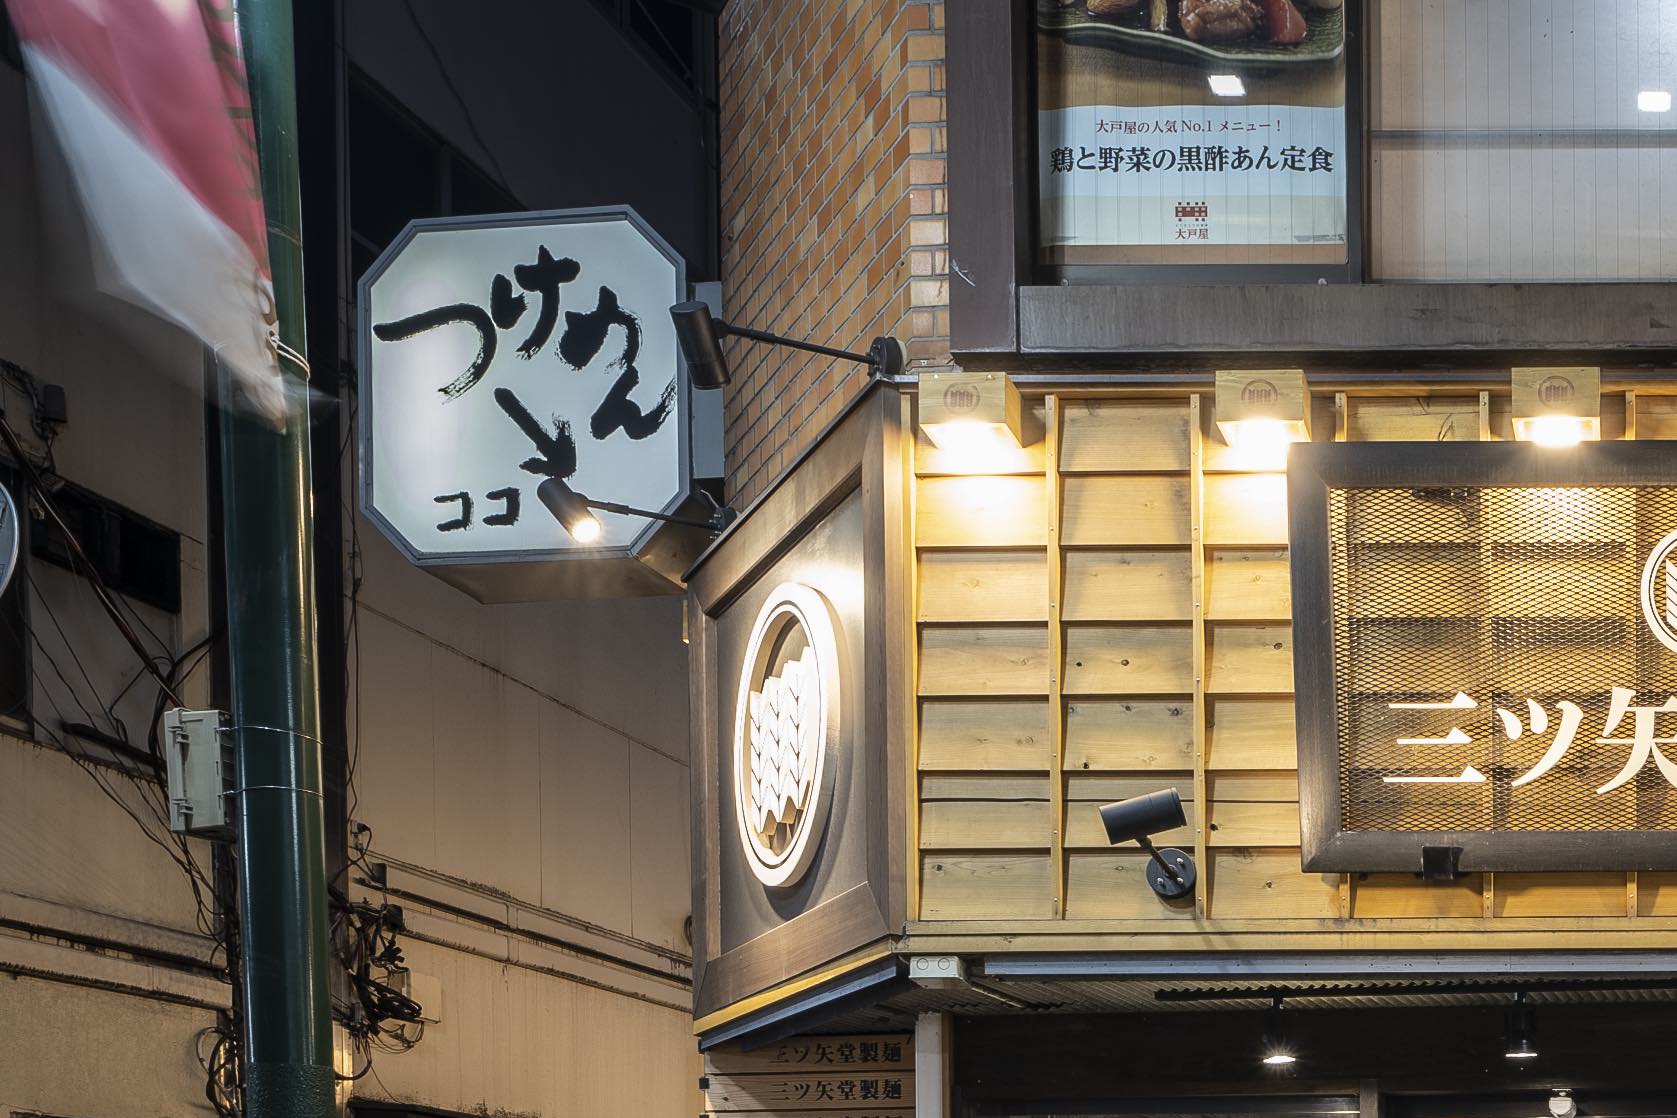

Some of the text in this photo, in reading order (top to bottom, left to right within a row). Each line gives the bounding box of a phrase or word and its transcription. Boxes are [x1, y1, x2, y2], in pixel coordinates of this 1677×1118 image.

[1050, 145, 1334, 174] 鶏と野菜の黒酢あん定食
[1175, 228, 1209, 240] 大戸屋
[373, 244, 678, 442] つけめん
[434, 486, 521, 534] ココ
[769, 1042, 902, 1063] 三ツ矢堂製麺
[770, 1079, 903, 1100] 三ツ矢堂製麺
